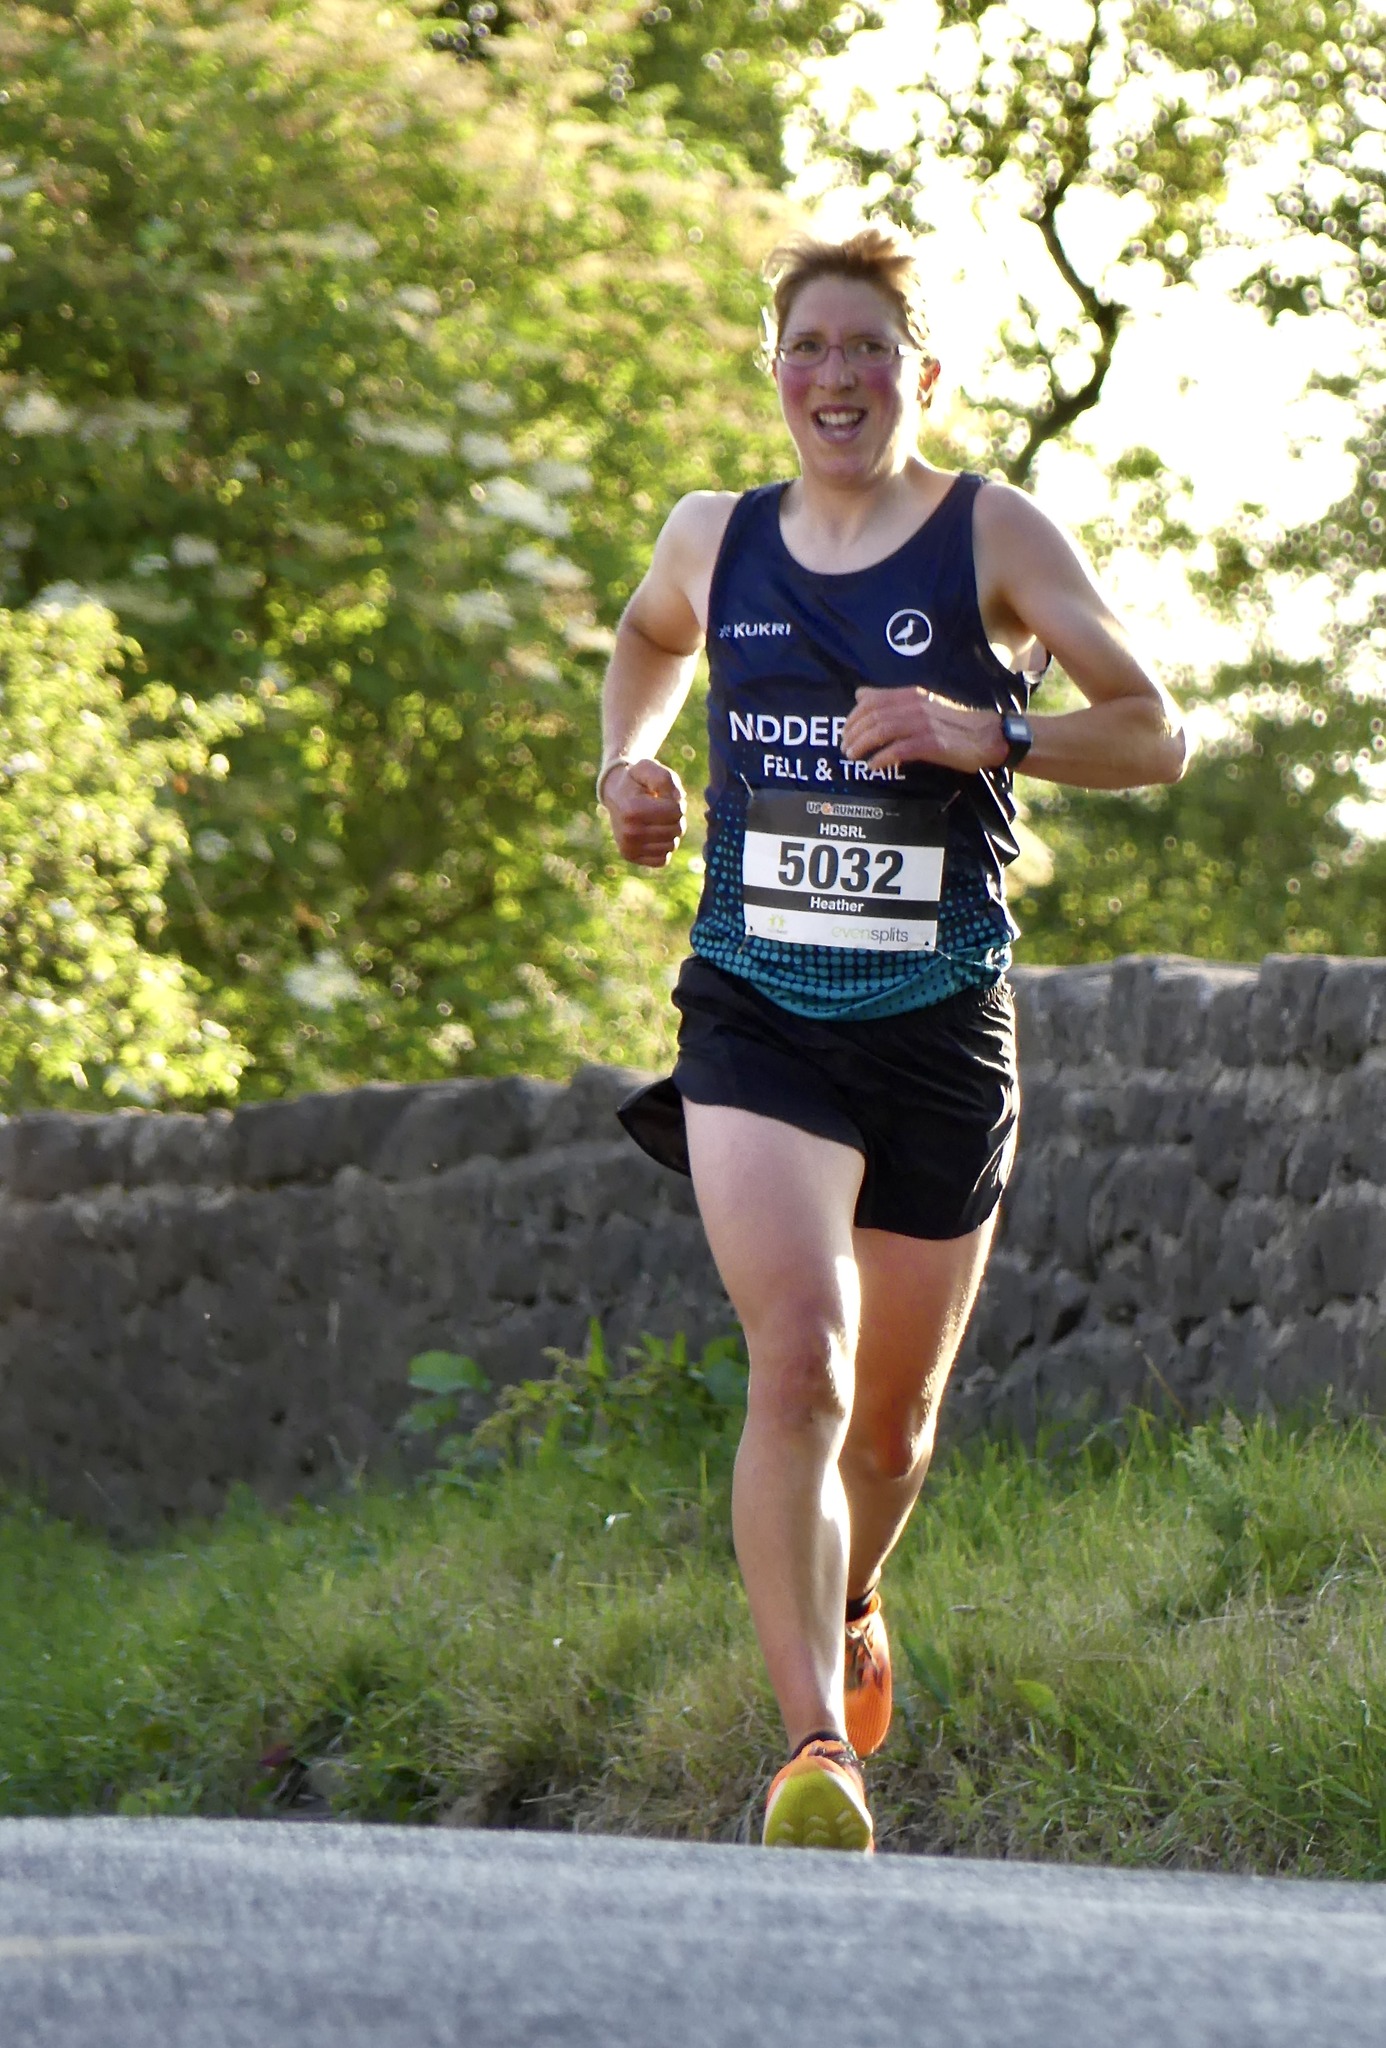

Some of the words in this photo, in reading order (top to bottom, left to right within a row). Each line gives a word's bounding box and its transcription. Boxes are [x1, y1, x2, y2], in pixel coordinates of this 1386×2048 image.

[733, 622, 791, 638] KUKRI
[764, 754, 809, 781] FELL
[815, 758, 833, 781] &
[839, 759, 906, 780] TRAIL
[820, 823, 866, 838] HDSRL
[778, 841, 904, 895] 5032
[810, 896, 864, 913] Heather
[832, 925, 909, 944] evensplits
